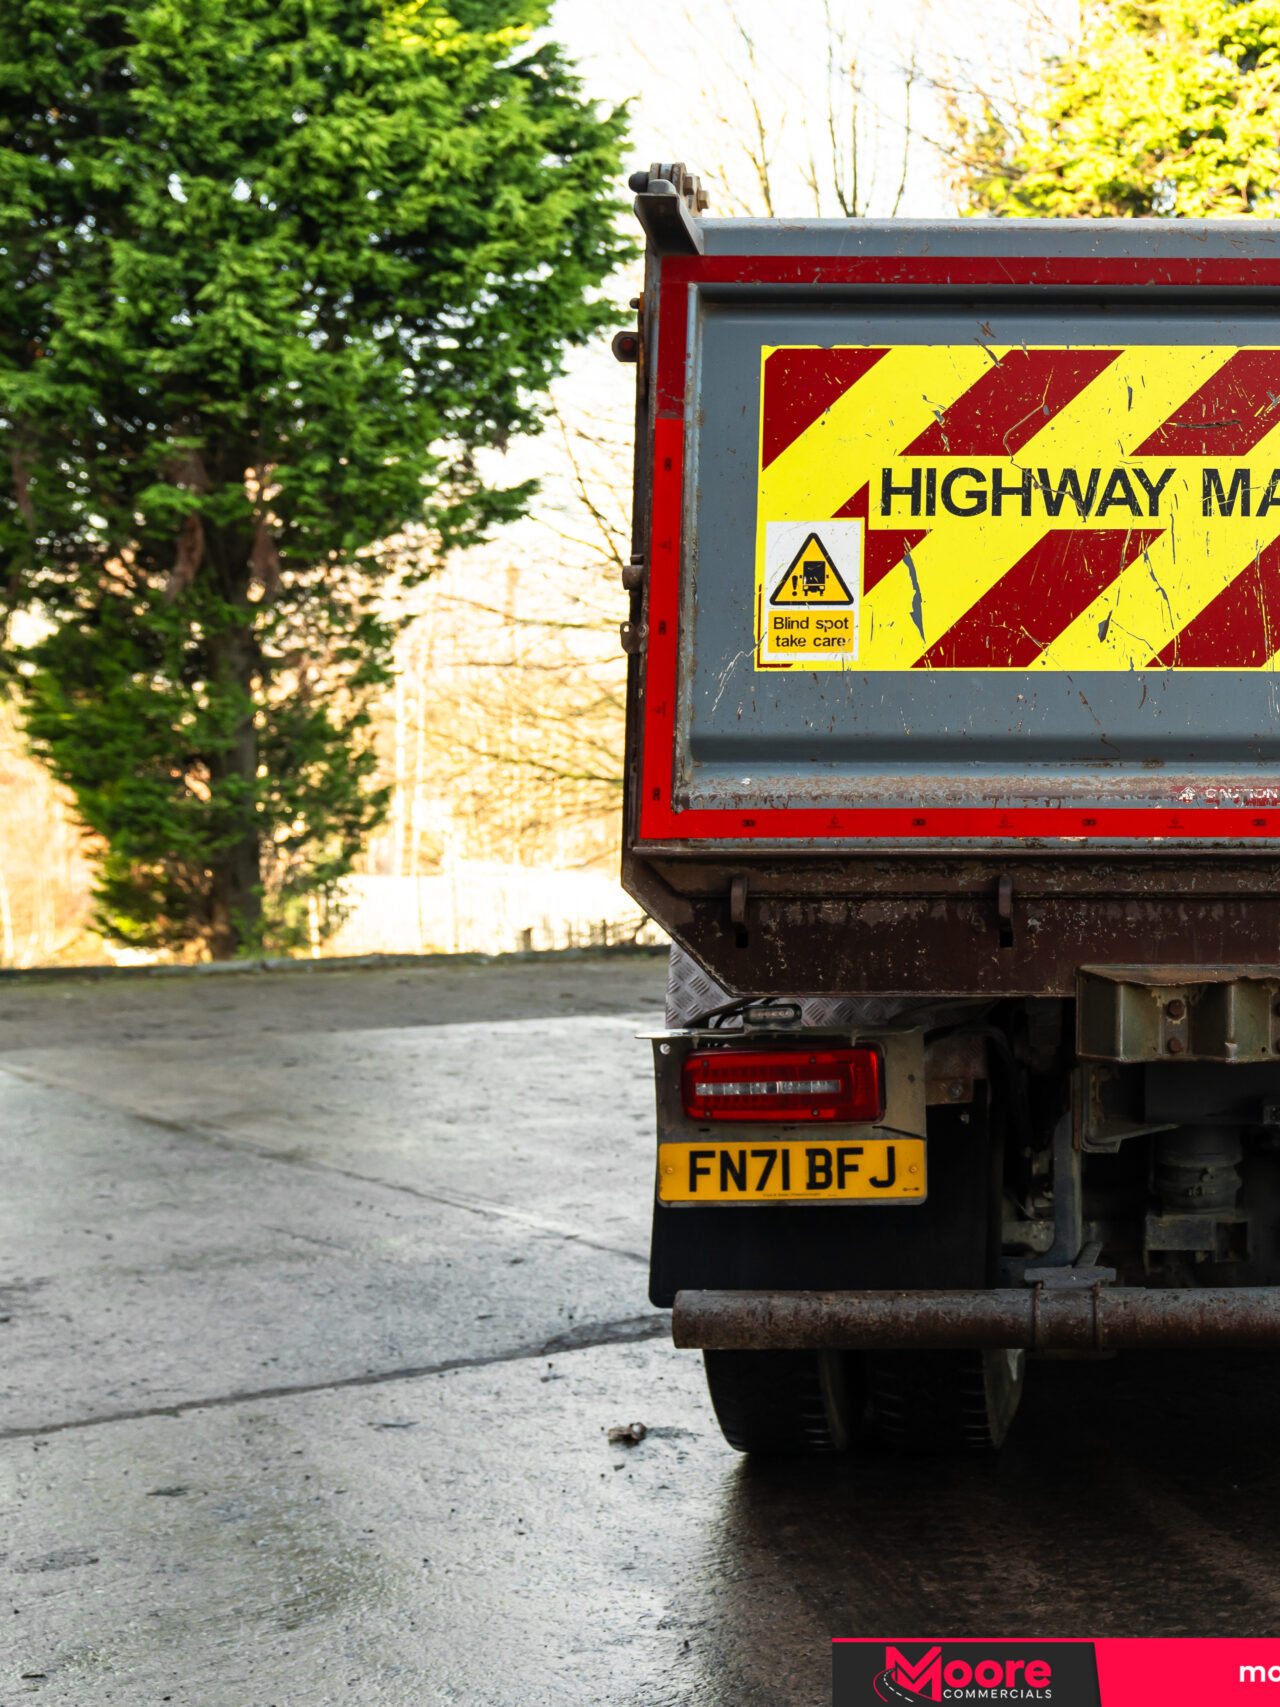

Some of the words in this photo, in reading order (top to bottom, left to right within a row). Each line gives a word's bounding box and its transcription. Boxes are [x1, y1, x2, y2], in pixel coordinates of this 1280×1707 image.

[880, 467, 1176, 519] HIGHWAY
[773, 616, 809, 630] Blind
[815, 617, 849, 633] spot
[775, 634, 807, 647] take
[812, 636, 846, 647] care
[688, 1148, 790, 1193] FN71
[805, 1146, 896, 1191] BFJ
